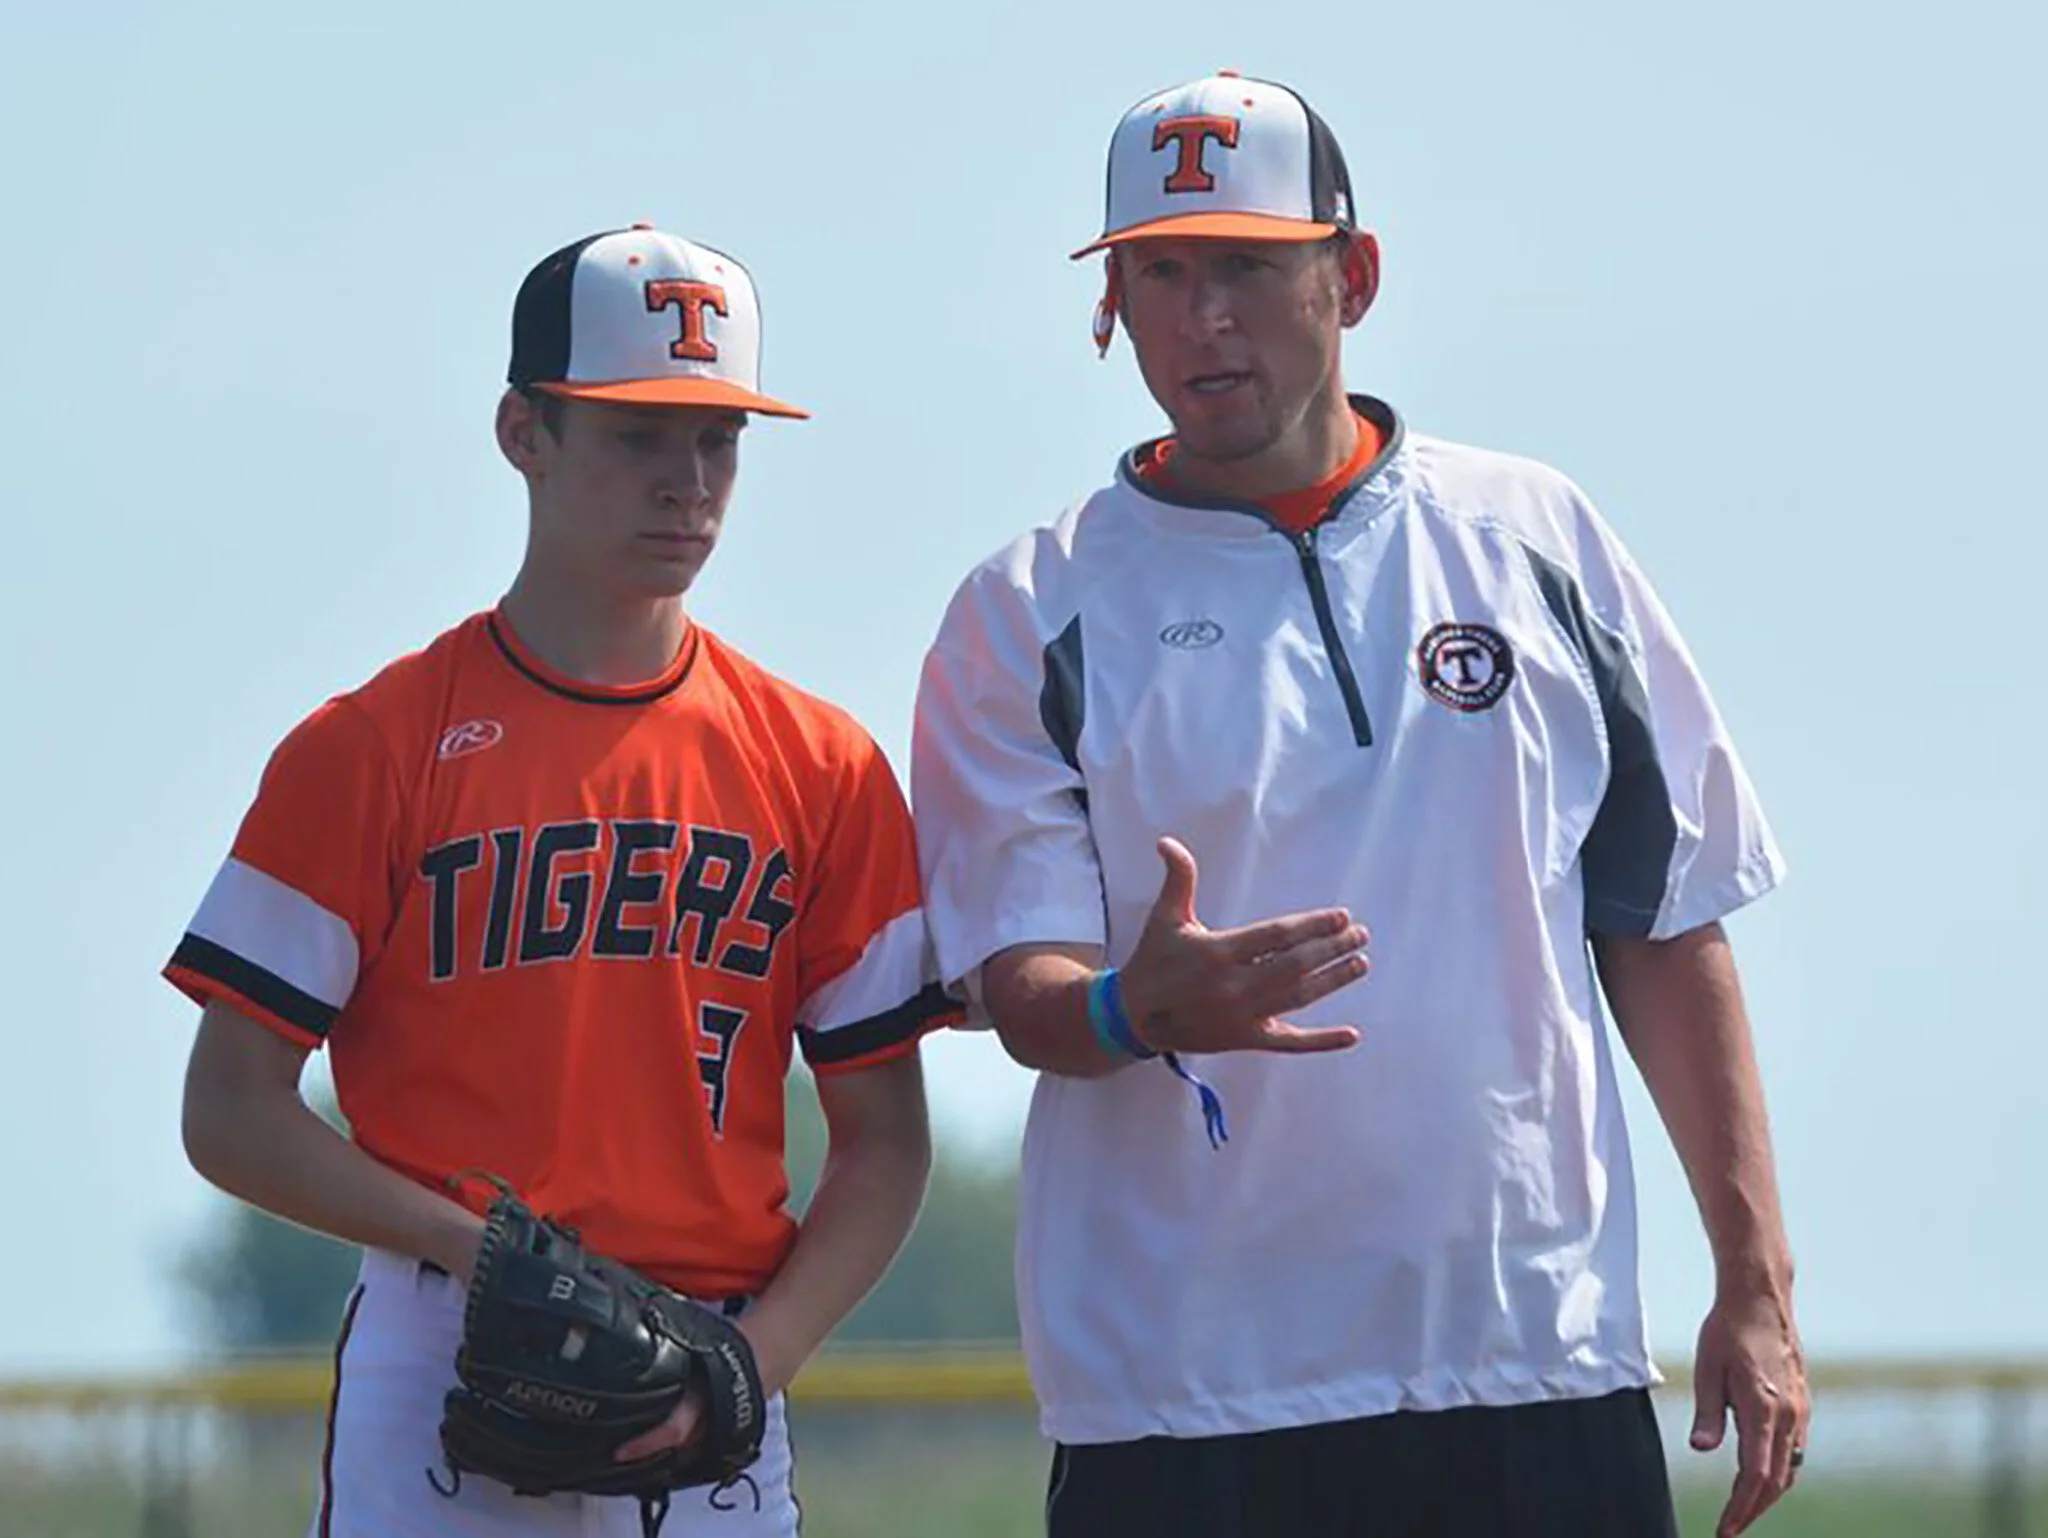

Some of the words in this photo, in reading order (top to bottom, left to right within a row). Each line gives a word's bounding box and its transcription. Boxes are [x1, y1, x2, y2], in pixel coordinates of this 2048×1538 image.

[1151, 114, 1240, 194] T
[645, 277, 728, 363] T
[1440, 647, 1483, 686] T
[418, 817, 797, 982] TIGERS
[503, 1379, 599, 1418] A2000
